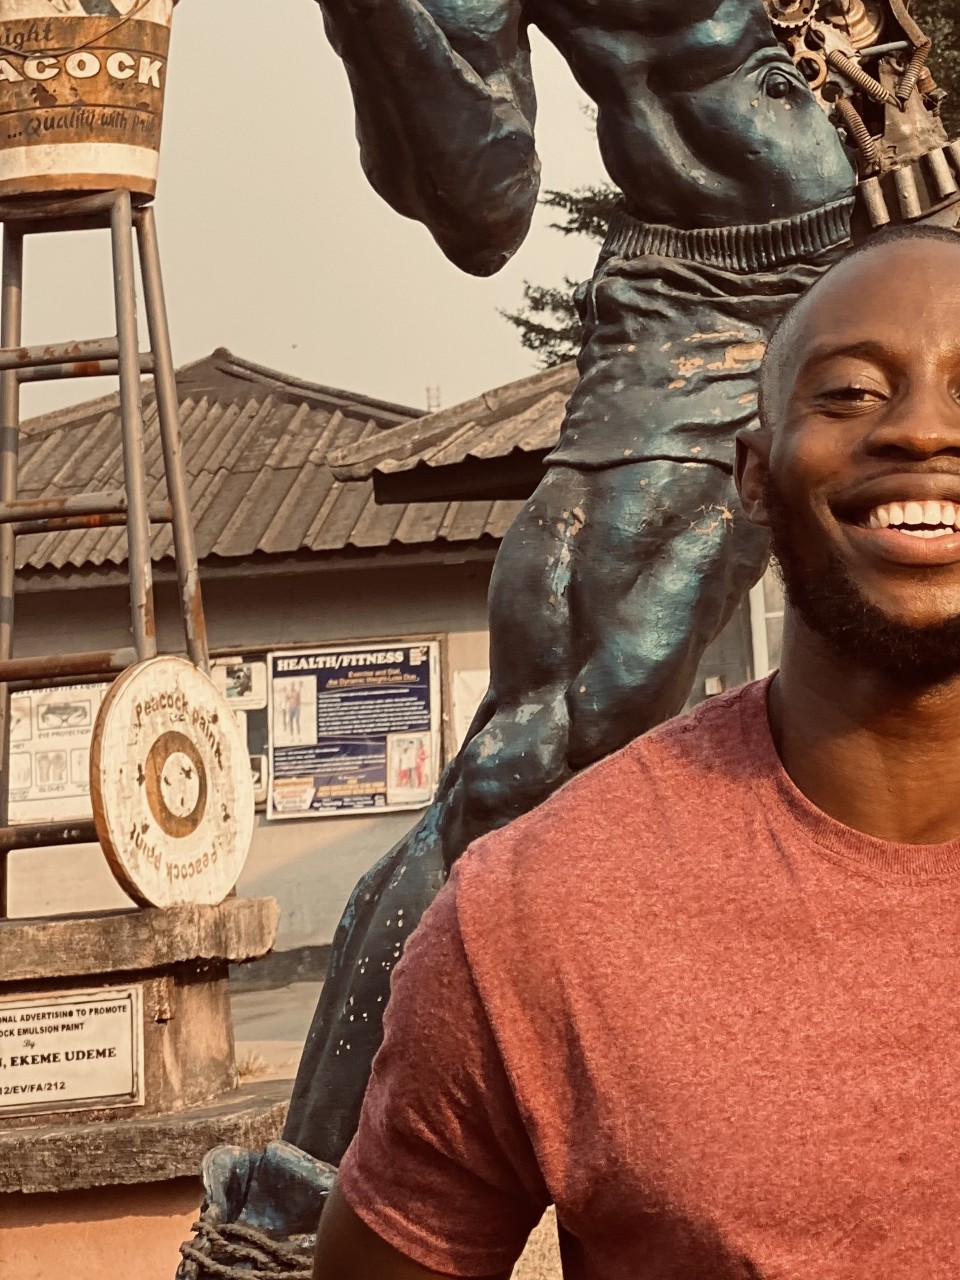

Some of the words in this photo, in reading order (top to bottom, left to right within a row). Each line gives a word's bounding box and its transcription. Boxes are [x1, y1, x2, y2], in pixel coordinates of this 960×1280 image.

[0, 23, 55, 52] ight
[277, 652, 404, 671] HEALTH/FITNESS
[0, 1014, 18, 1024] NAL
[20, 1009, 74, 1023] ADVERTISING
[75, 1008, 87, 1018] TO
[89, 1004, 128, 1016] PROMOTE
[17, 1024, 59, 1036] EMULSION
[61, 1022, 85, 1033] PAINT
[23, 1039, 36, 1049] By
[10, 1052, 61, 1067] EKEME
[65, 1046, 117, 1062] UDEME
